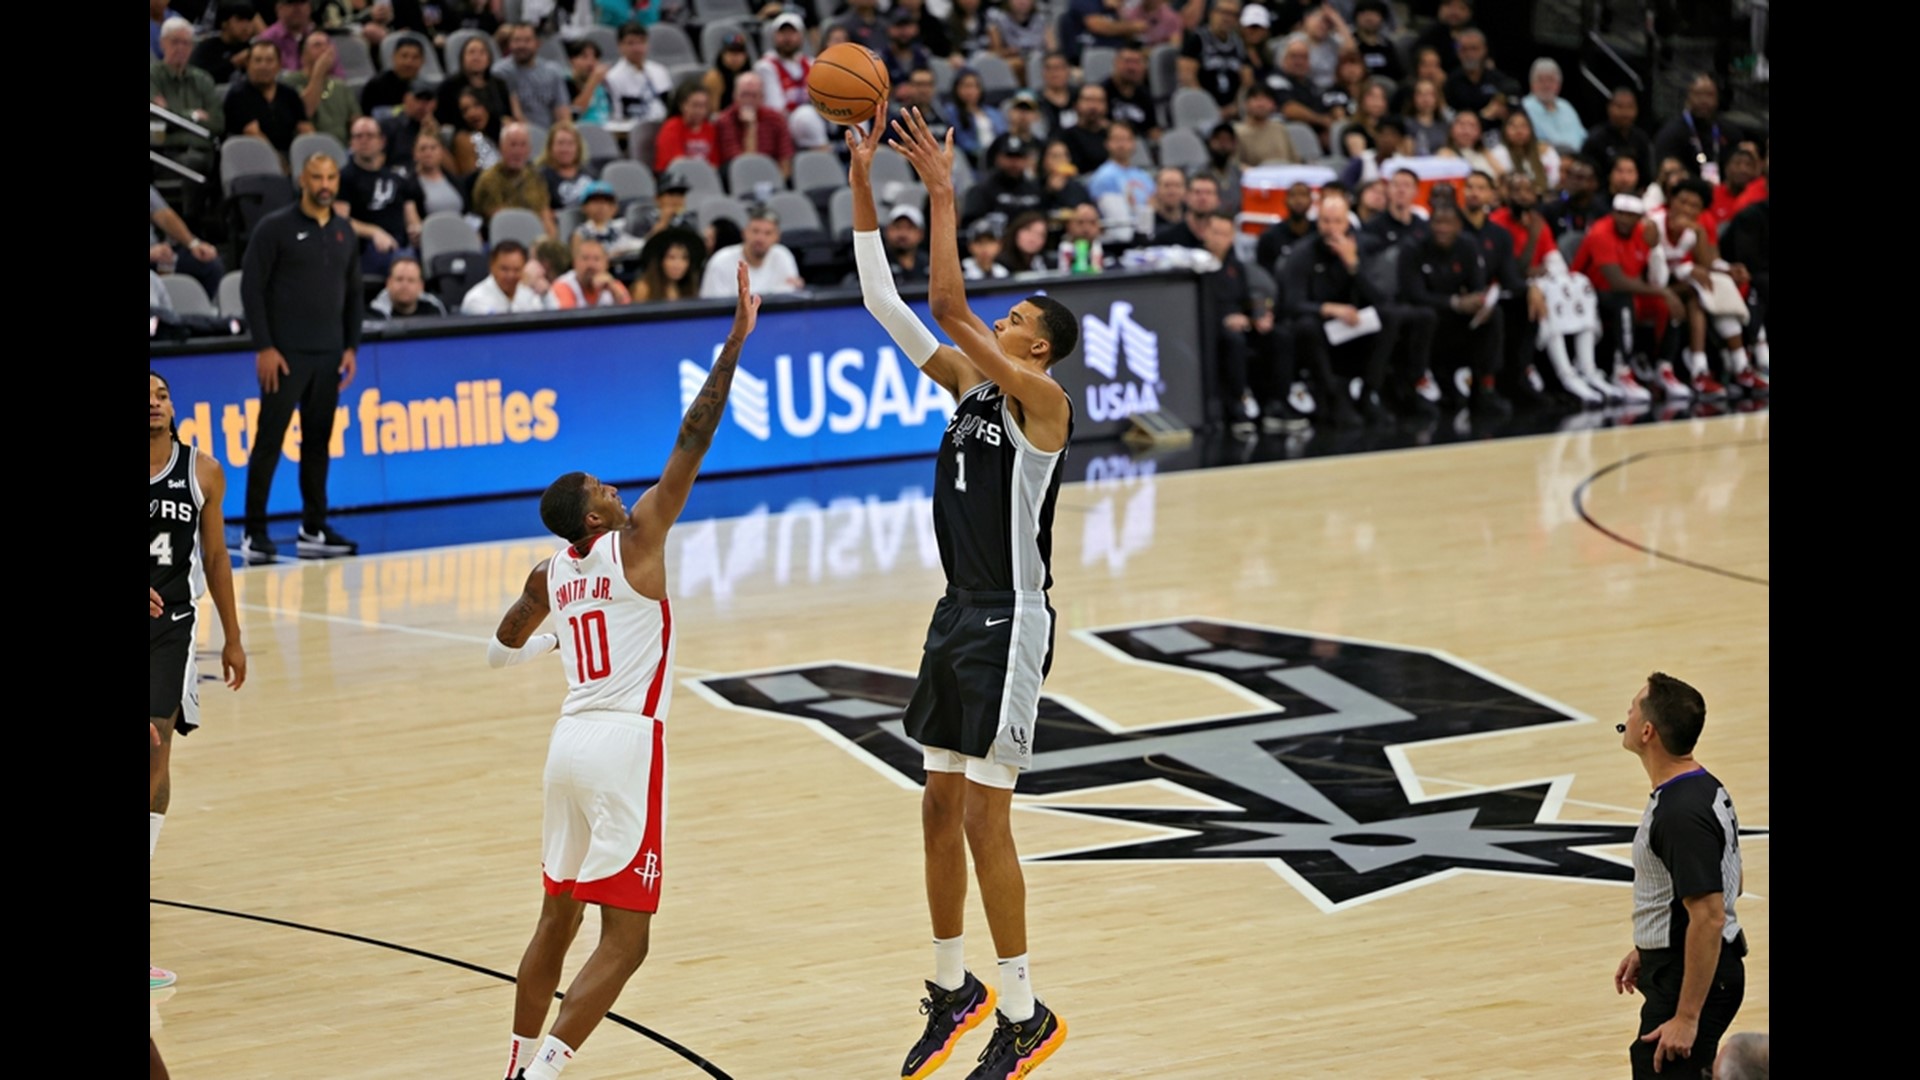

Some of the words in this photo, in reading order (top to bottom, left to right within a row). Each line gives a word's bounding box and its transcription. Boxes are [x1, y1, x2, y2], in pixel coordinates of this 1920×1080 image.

[358, 379, 559, 455] families
[775, 346, 958, 438] USAA
[1086, 382, 1160, 422] USAA
[955, 451, 967, 493] 1
[556, 578, 588, 611] SMITH
[592, 576, 613, 601] JR.
[569, 610, 611, 684] 10
